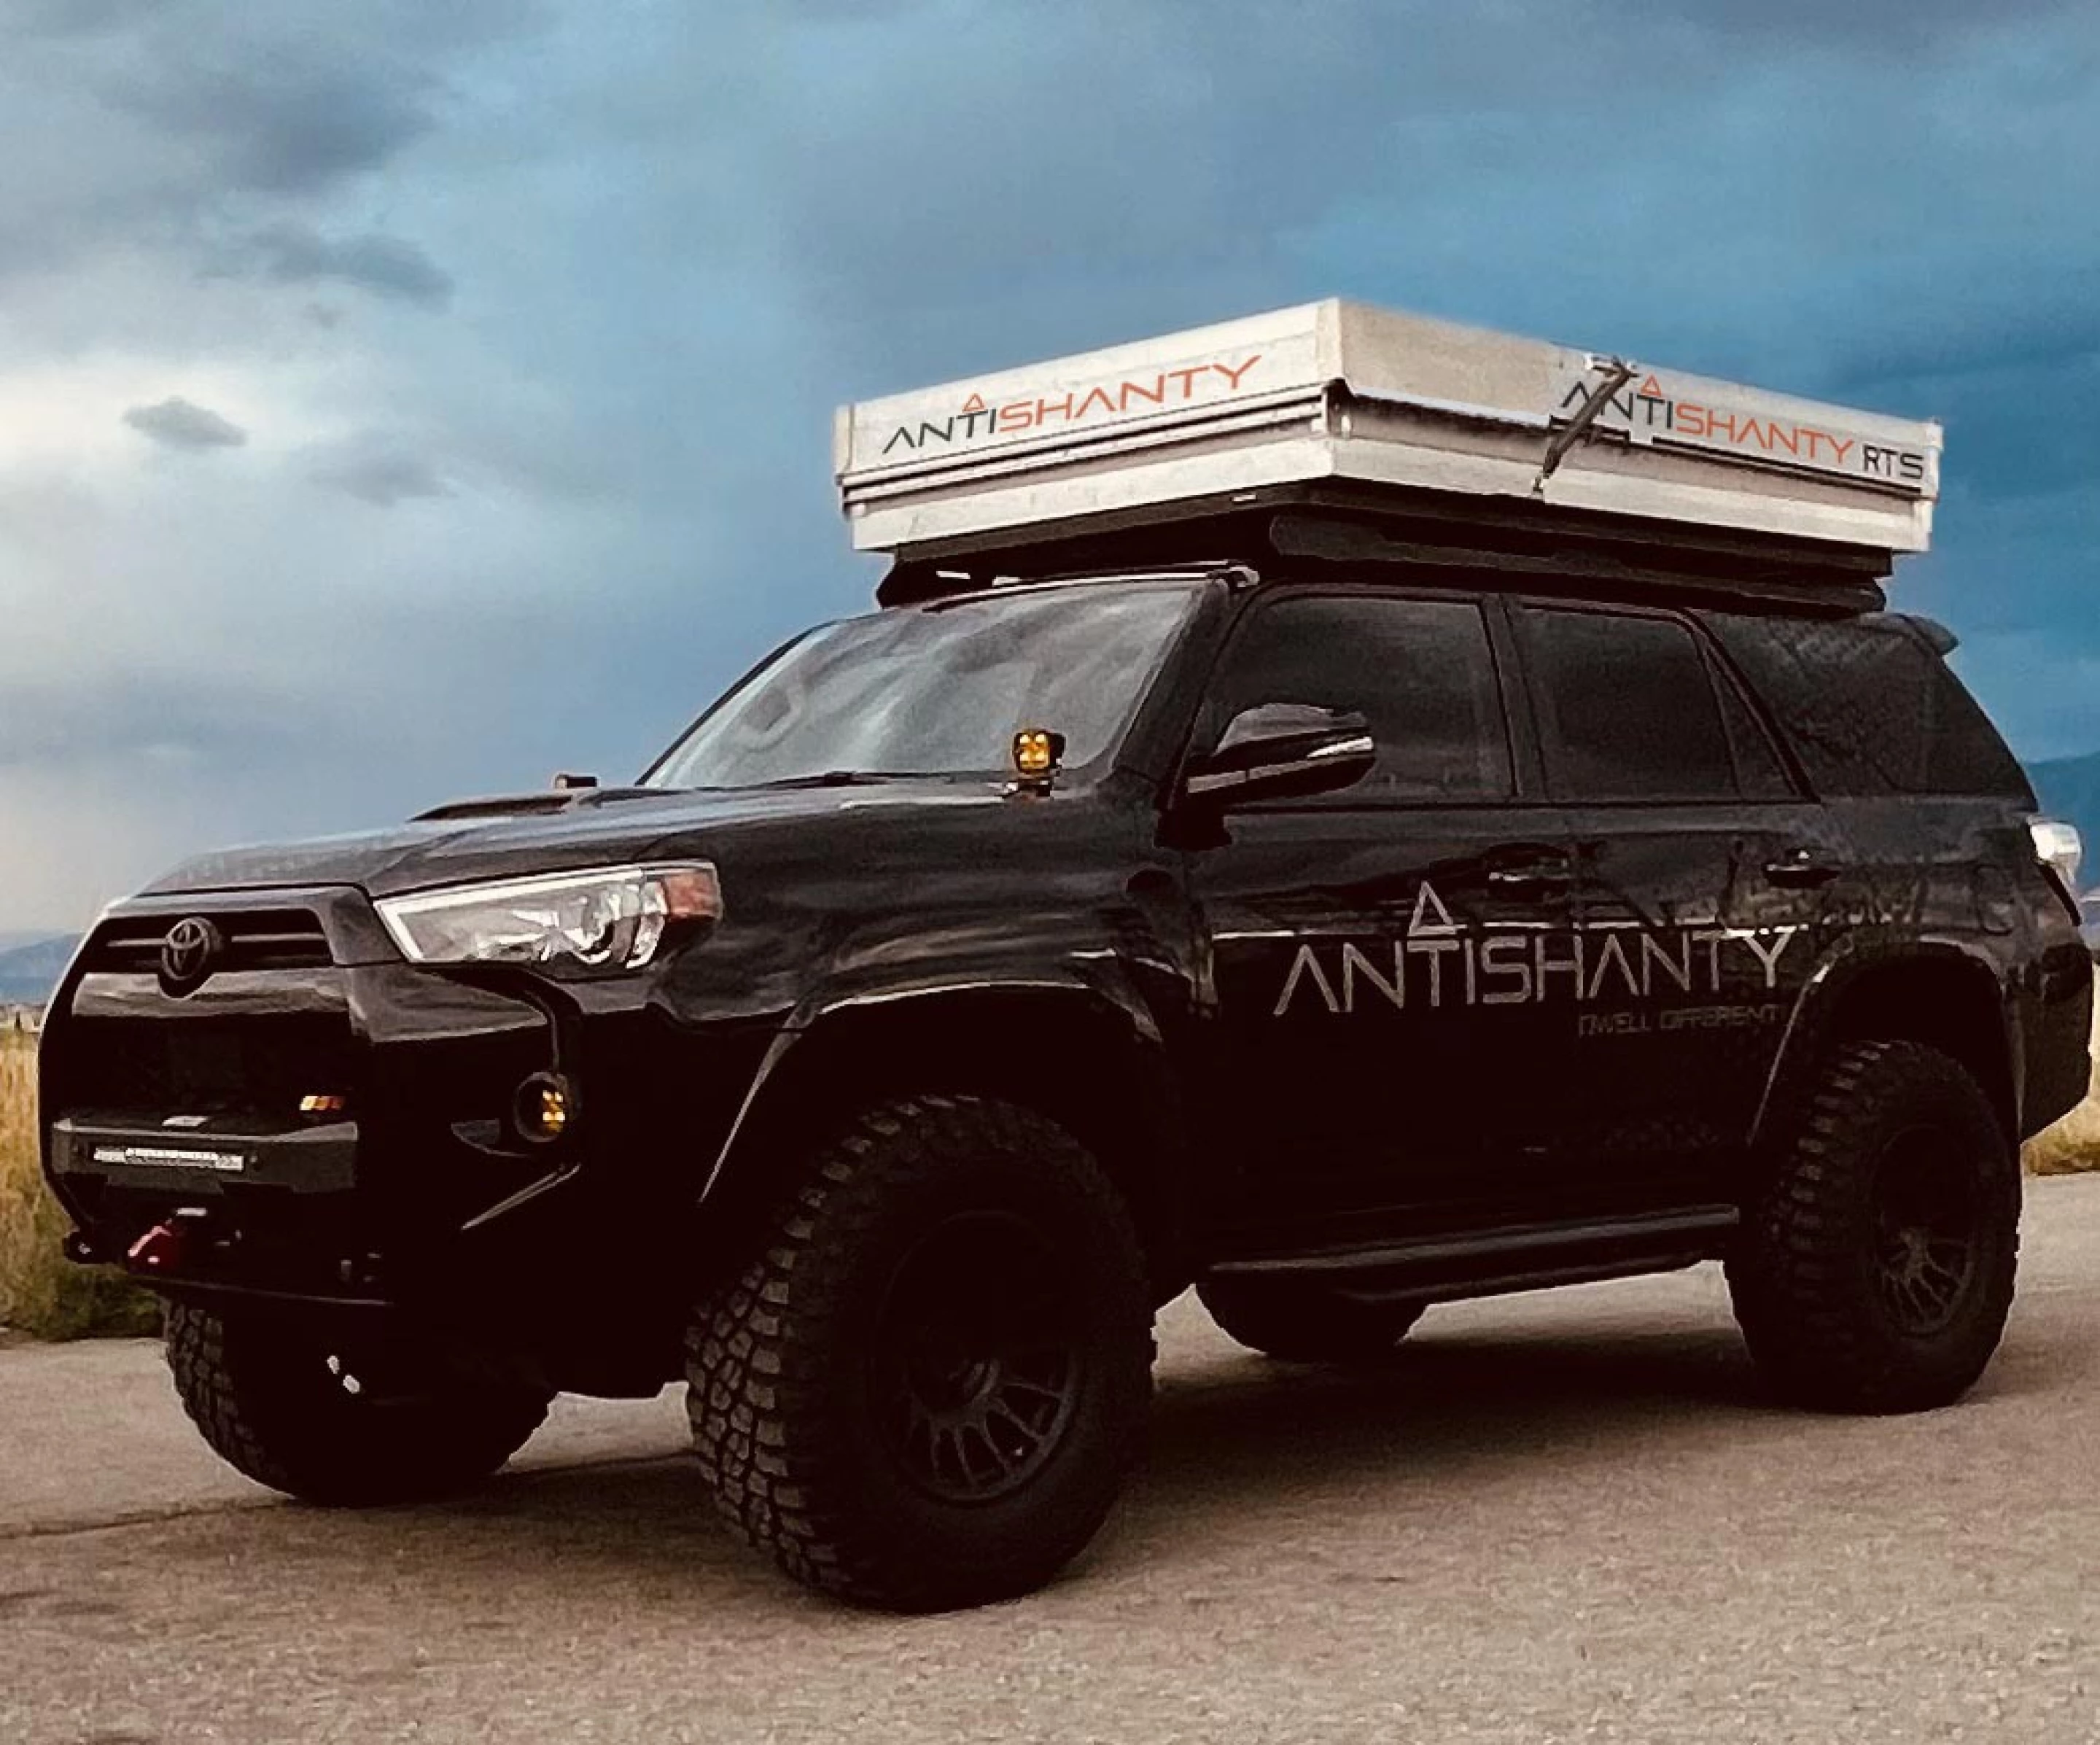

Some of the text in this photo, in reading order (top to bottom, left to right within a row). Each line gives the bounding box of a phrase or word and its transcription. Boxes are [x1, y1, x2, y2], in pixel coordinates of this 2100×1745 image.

[882, 354, 1262, 455] ANTISHANTY
[1862, 443, 1925, 481] RTS
[1273, 929, 1796, 1016] ANTISHANTY
